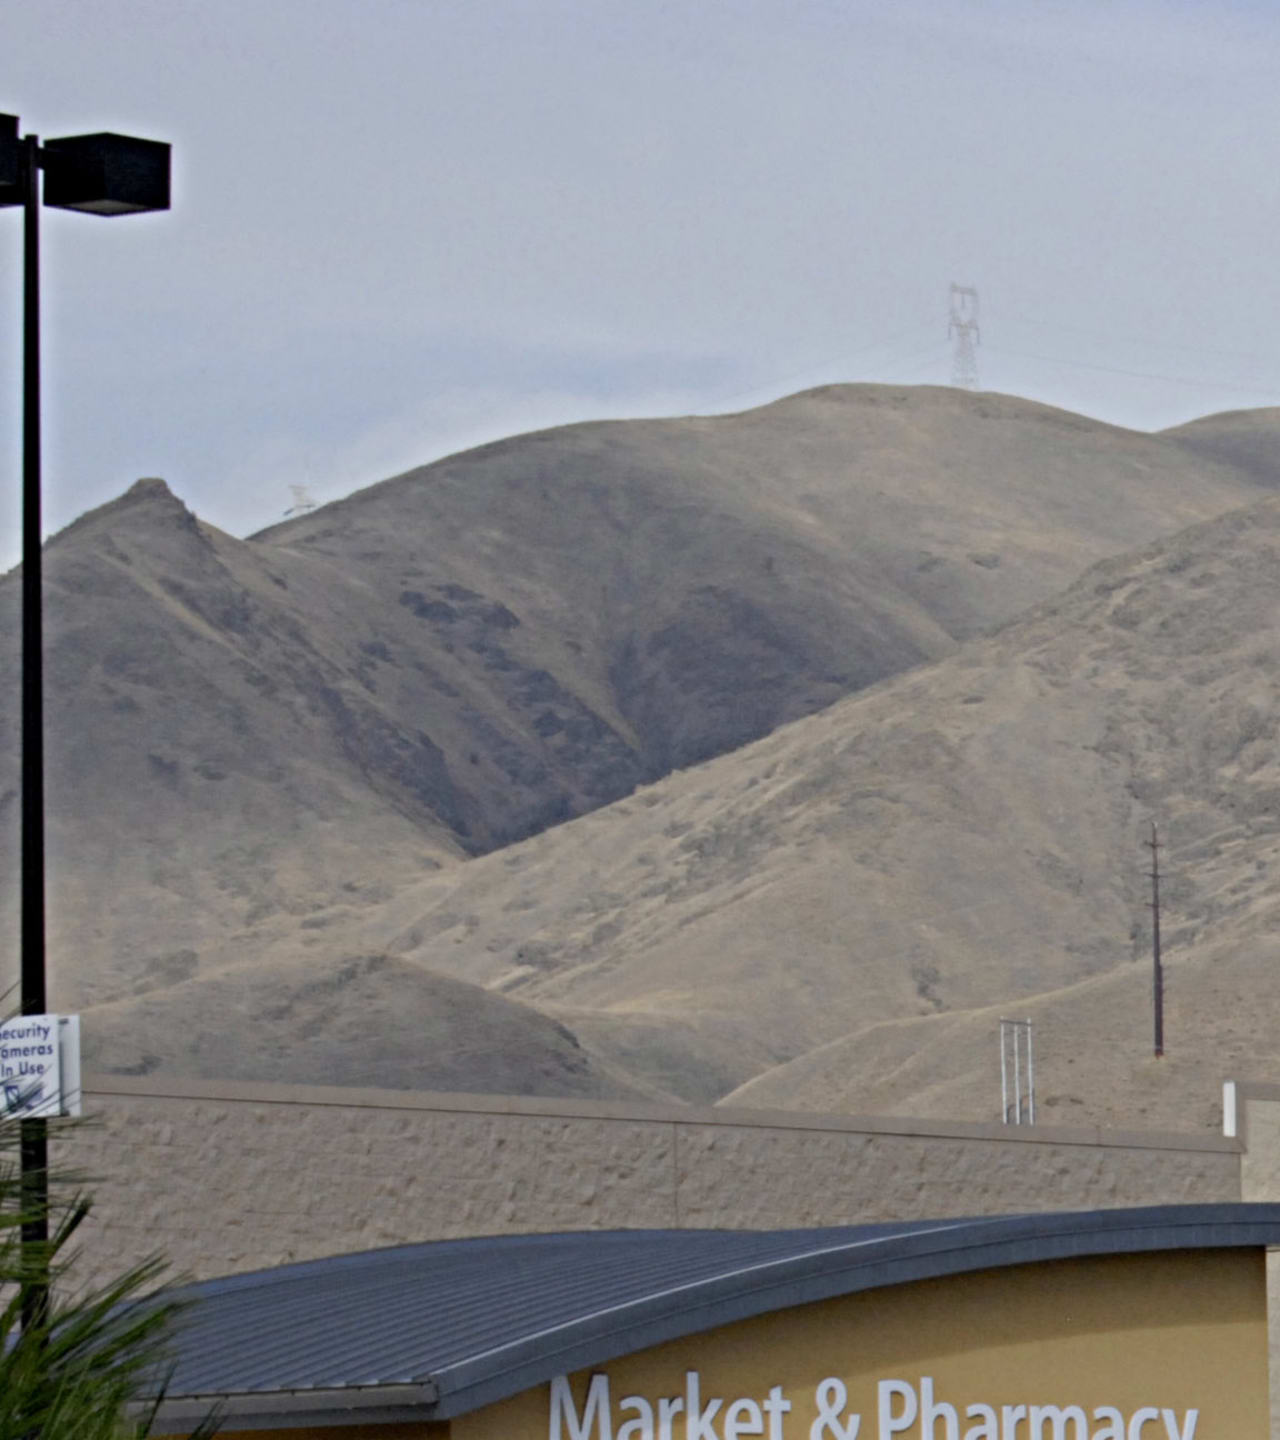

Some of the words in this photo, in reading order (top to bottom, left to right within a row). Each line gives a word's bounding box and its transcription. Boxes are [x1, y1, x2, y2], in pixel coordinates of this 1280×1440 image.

[0, 1025, 50, 1041] ecurity
[0, 1044, 53, 1059] ameras
[1, 1064, 13, 1077] In
[20, 1062, 44, 1076] Use
